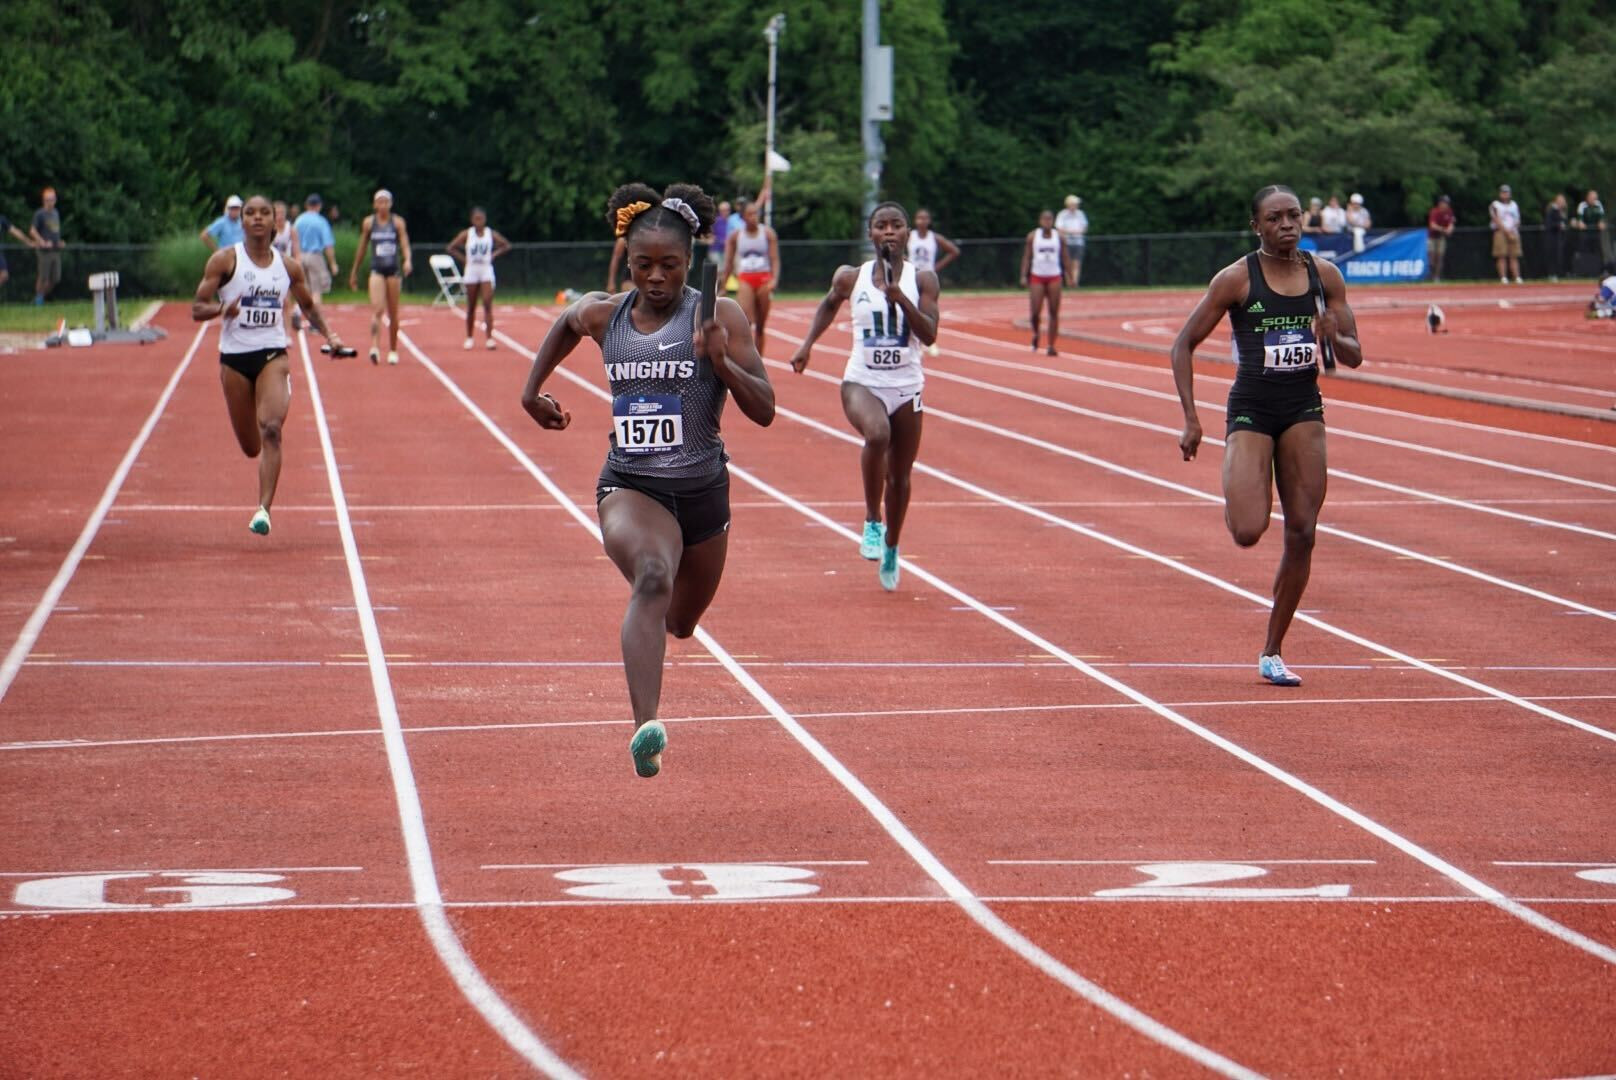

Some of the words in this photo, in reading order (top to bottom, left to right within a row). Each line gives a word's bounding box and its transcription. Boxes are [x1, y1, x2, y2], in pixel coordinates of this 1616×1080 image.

[1346, 261, 1381, 277] TRACK
[1393, 259, 1424, 276] FIELD
[246, 310, 276, 324] 1601
[873, 350, 901, 364] 626
[1273, 346, 1312, 366] 1458
[604, 360, 695, 381] KNIGHTS
[621, 418, 675, 445] 1570
[553, 864, 821, 900] 8
